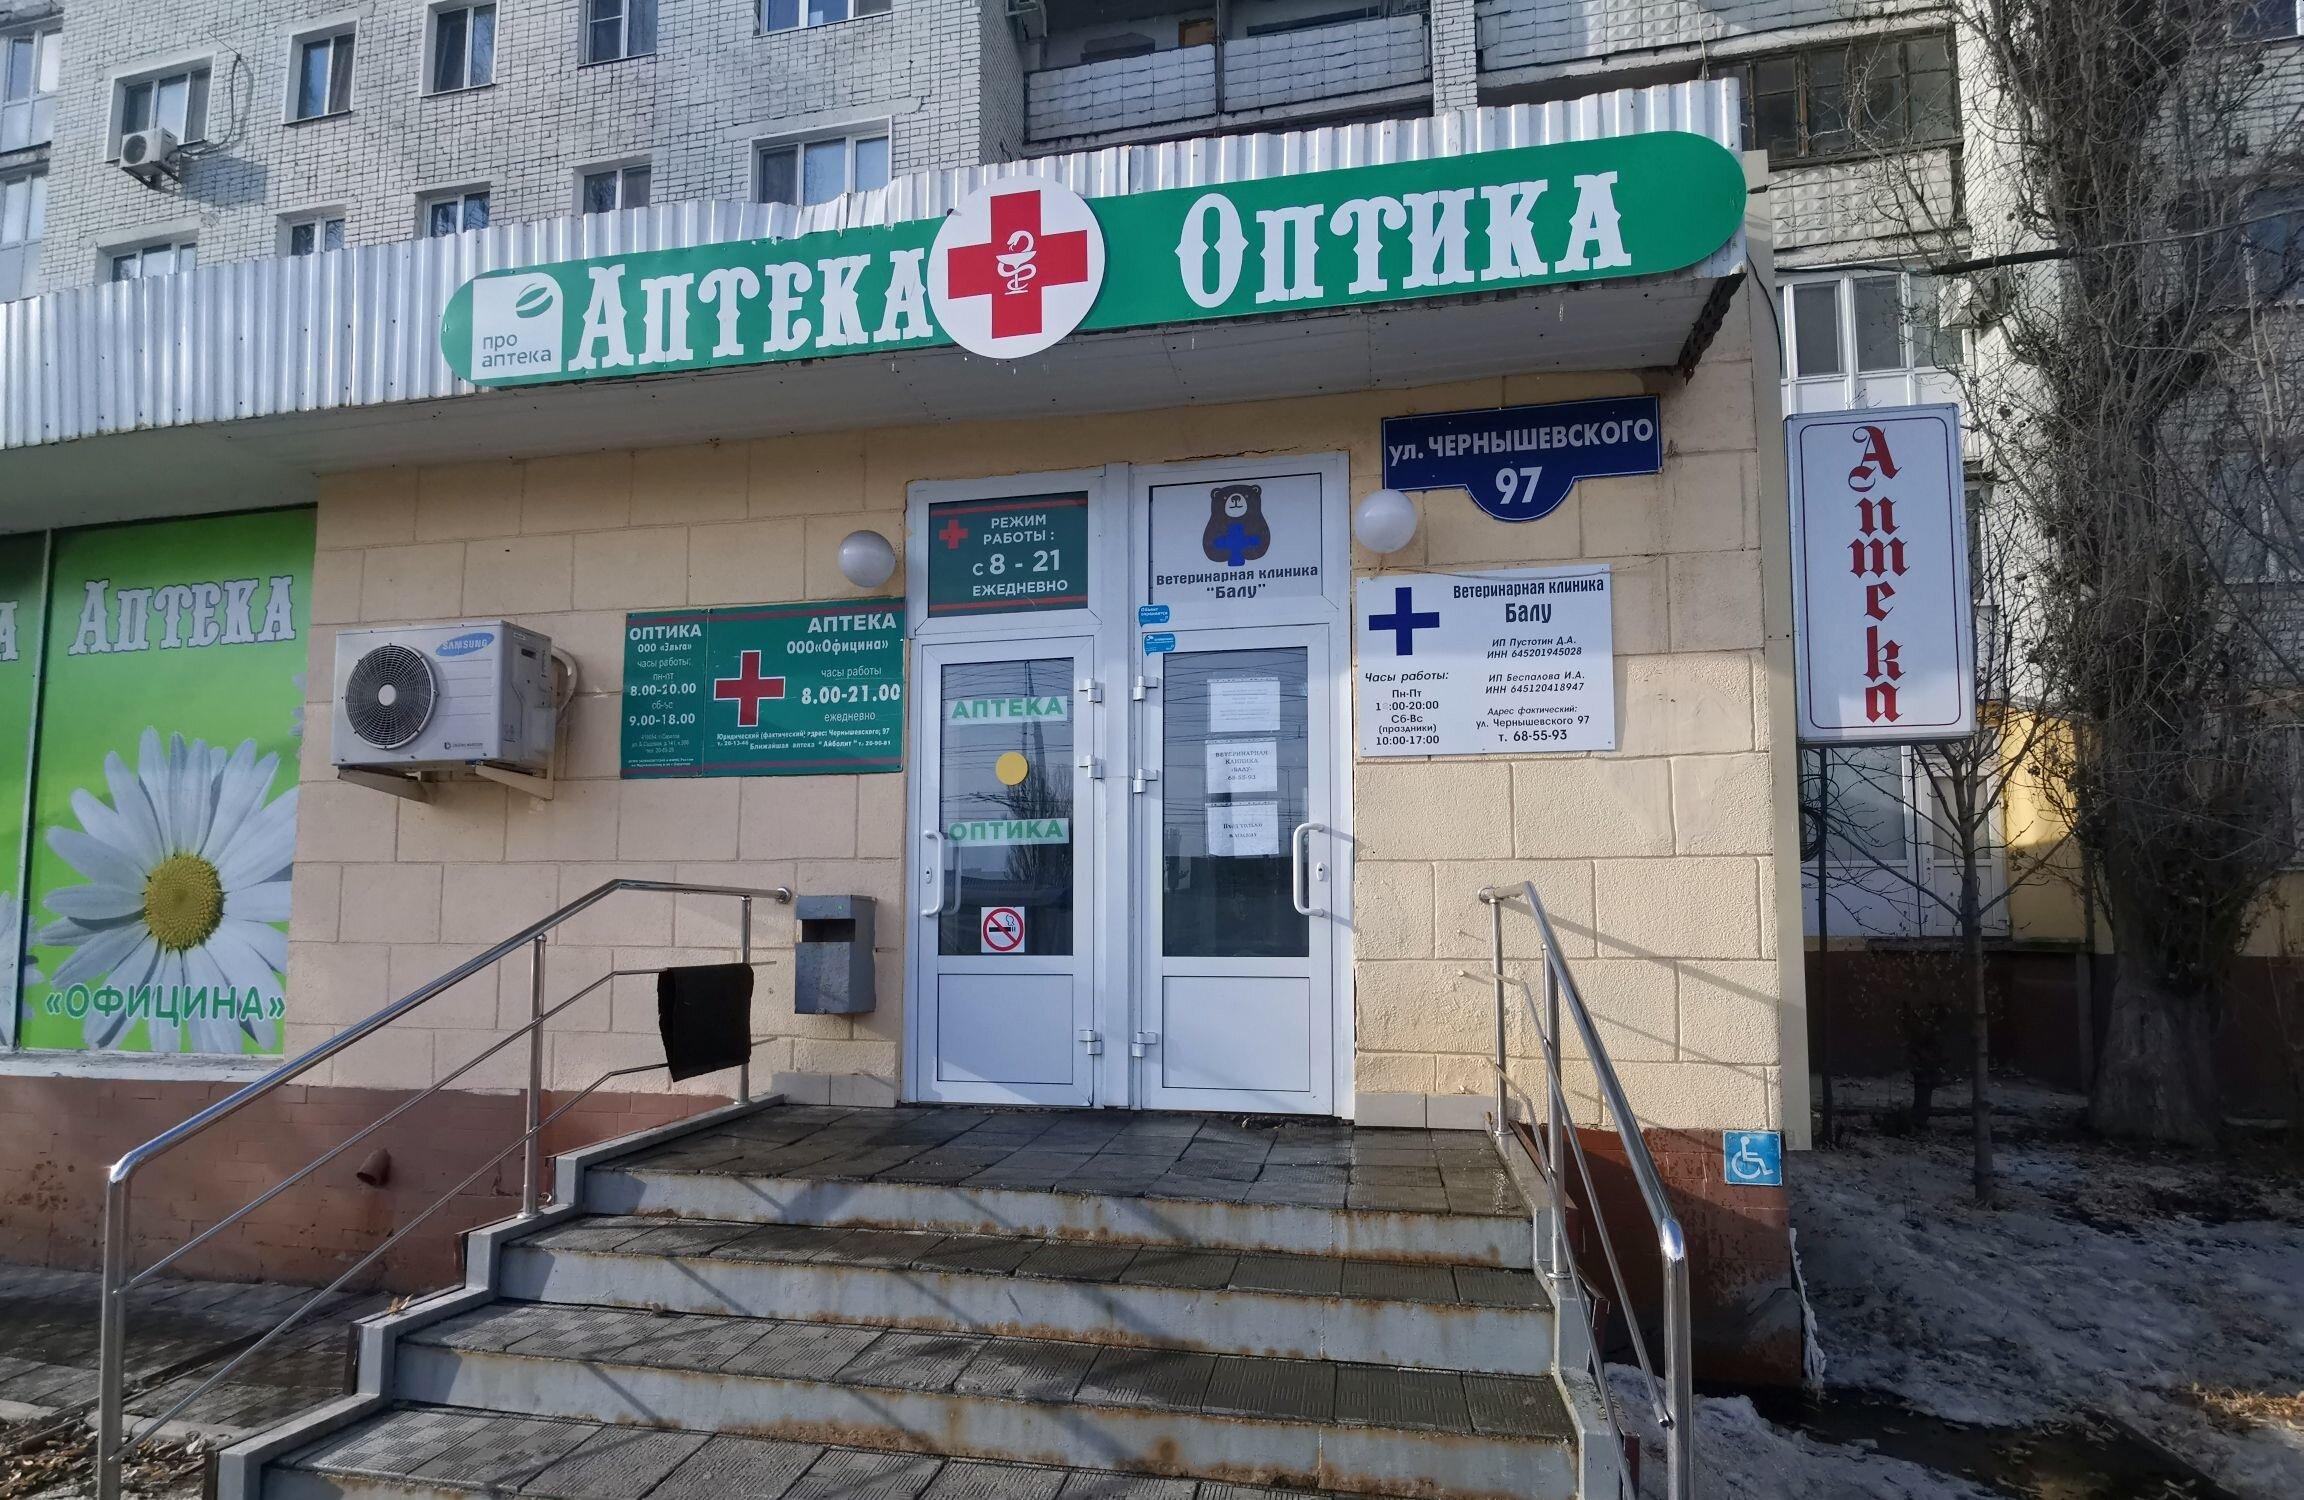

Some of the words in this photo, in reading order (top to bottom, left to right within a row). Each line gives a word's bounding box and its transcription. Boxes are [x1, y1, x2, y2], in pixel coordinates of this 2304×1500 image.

[483, 334, 518, 351] про
[482, 349, 552, 367] аптека
[1388, 445, 1424, 466] ул.
[1428, 418, 1654, 457] ЧЕРНЫШЕВСКОГО
[1496, 466, 1542, 504] 97
[991, 515, 1046, 529] РЕЖИМ
[989, 553, 1006, 575] 8
[1033, 549, 1060, 572] 21
[1156, 570, 1254, 586] Ветеринарная
[1259, 566, 1318, 579] клиника
[973, 580, 1068, 597] ЕЖЕДНЕВНО
[1453, 582, 1545, 599] Ветеринарная
[1549, 579, 1604, 593] клиника
[1505, 603, 1552, 623] Балу
[807, 613, 897, 633] АПТЕКА
[629, 624, 702, 640] ОПТИКА
[442, 639, 488, 650] SAMSUNG
[638, 643, 657, 653] ООО
[1492, 638, 1505, 647] ИП
[1510, 638, 1553, 648] Пустотин
[1556, 636, 1576, 645] Д.А.
[1487, 650, 1507, 659] ИНН
[1511, 647, 1582, 658] 645201945028
[821, 669, 844, 677] часы
[847, 666, 881, 678] работы
[1365, 672, 1396, 682] Часы
[1400, 671, 1449, 683] работы:
[1488, 674, 1502, 682] ИП
[1507, 673, 1560, 682] Беспалова
[1564, 671, 1585, 679] И.А.
[630, 683, 696, 696] 8.00-20.00
[801, 684, 900, 704] 8.00-21.00
[1392, 689, 1422, 698] Пн-Пт
[1485, 686, 1506, 694] ИНН
[1510, 683, 1585, 694] 645120418947
[952, 695, 1064, 719] АПТЕКА
[1487, 708, 1514, 716] Адрес
[1518, 705, 1578, 716] фактический:
[629, 713, 696, 726] 9.00-18.00
[824, 712, 876, 722] ежедневно
[1391, 714, 1423, 723] Сб-Вс
[1476, 720, 1489, 729] ул.
[1493, 717, 1573, 728] Чернышевского
[1577, 716, 1589, 724] 97
[1378, 724, 1437, 734] (праздники)
[1376, 735, 1440, 745] 10:00-17:00
[1498, 734, 1507, 742] т.
[1513, 730, 1567, 741] 68-55-93
[950, 820, 1064, 841] ОПТИКА
[46, 983, 286, 1028] «ОФИЦИНА»
